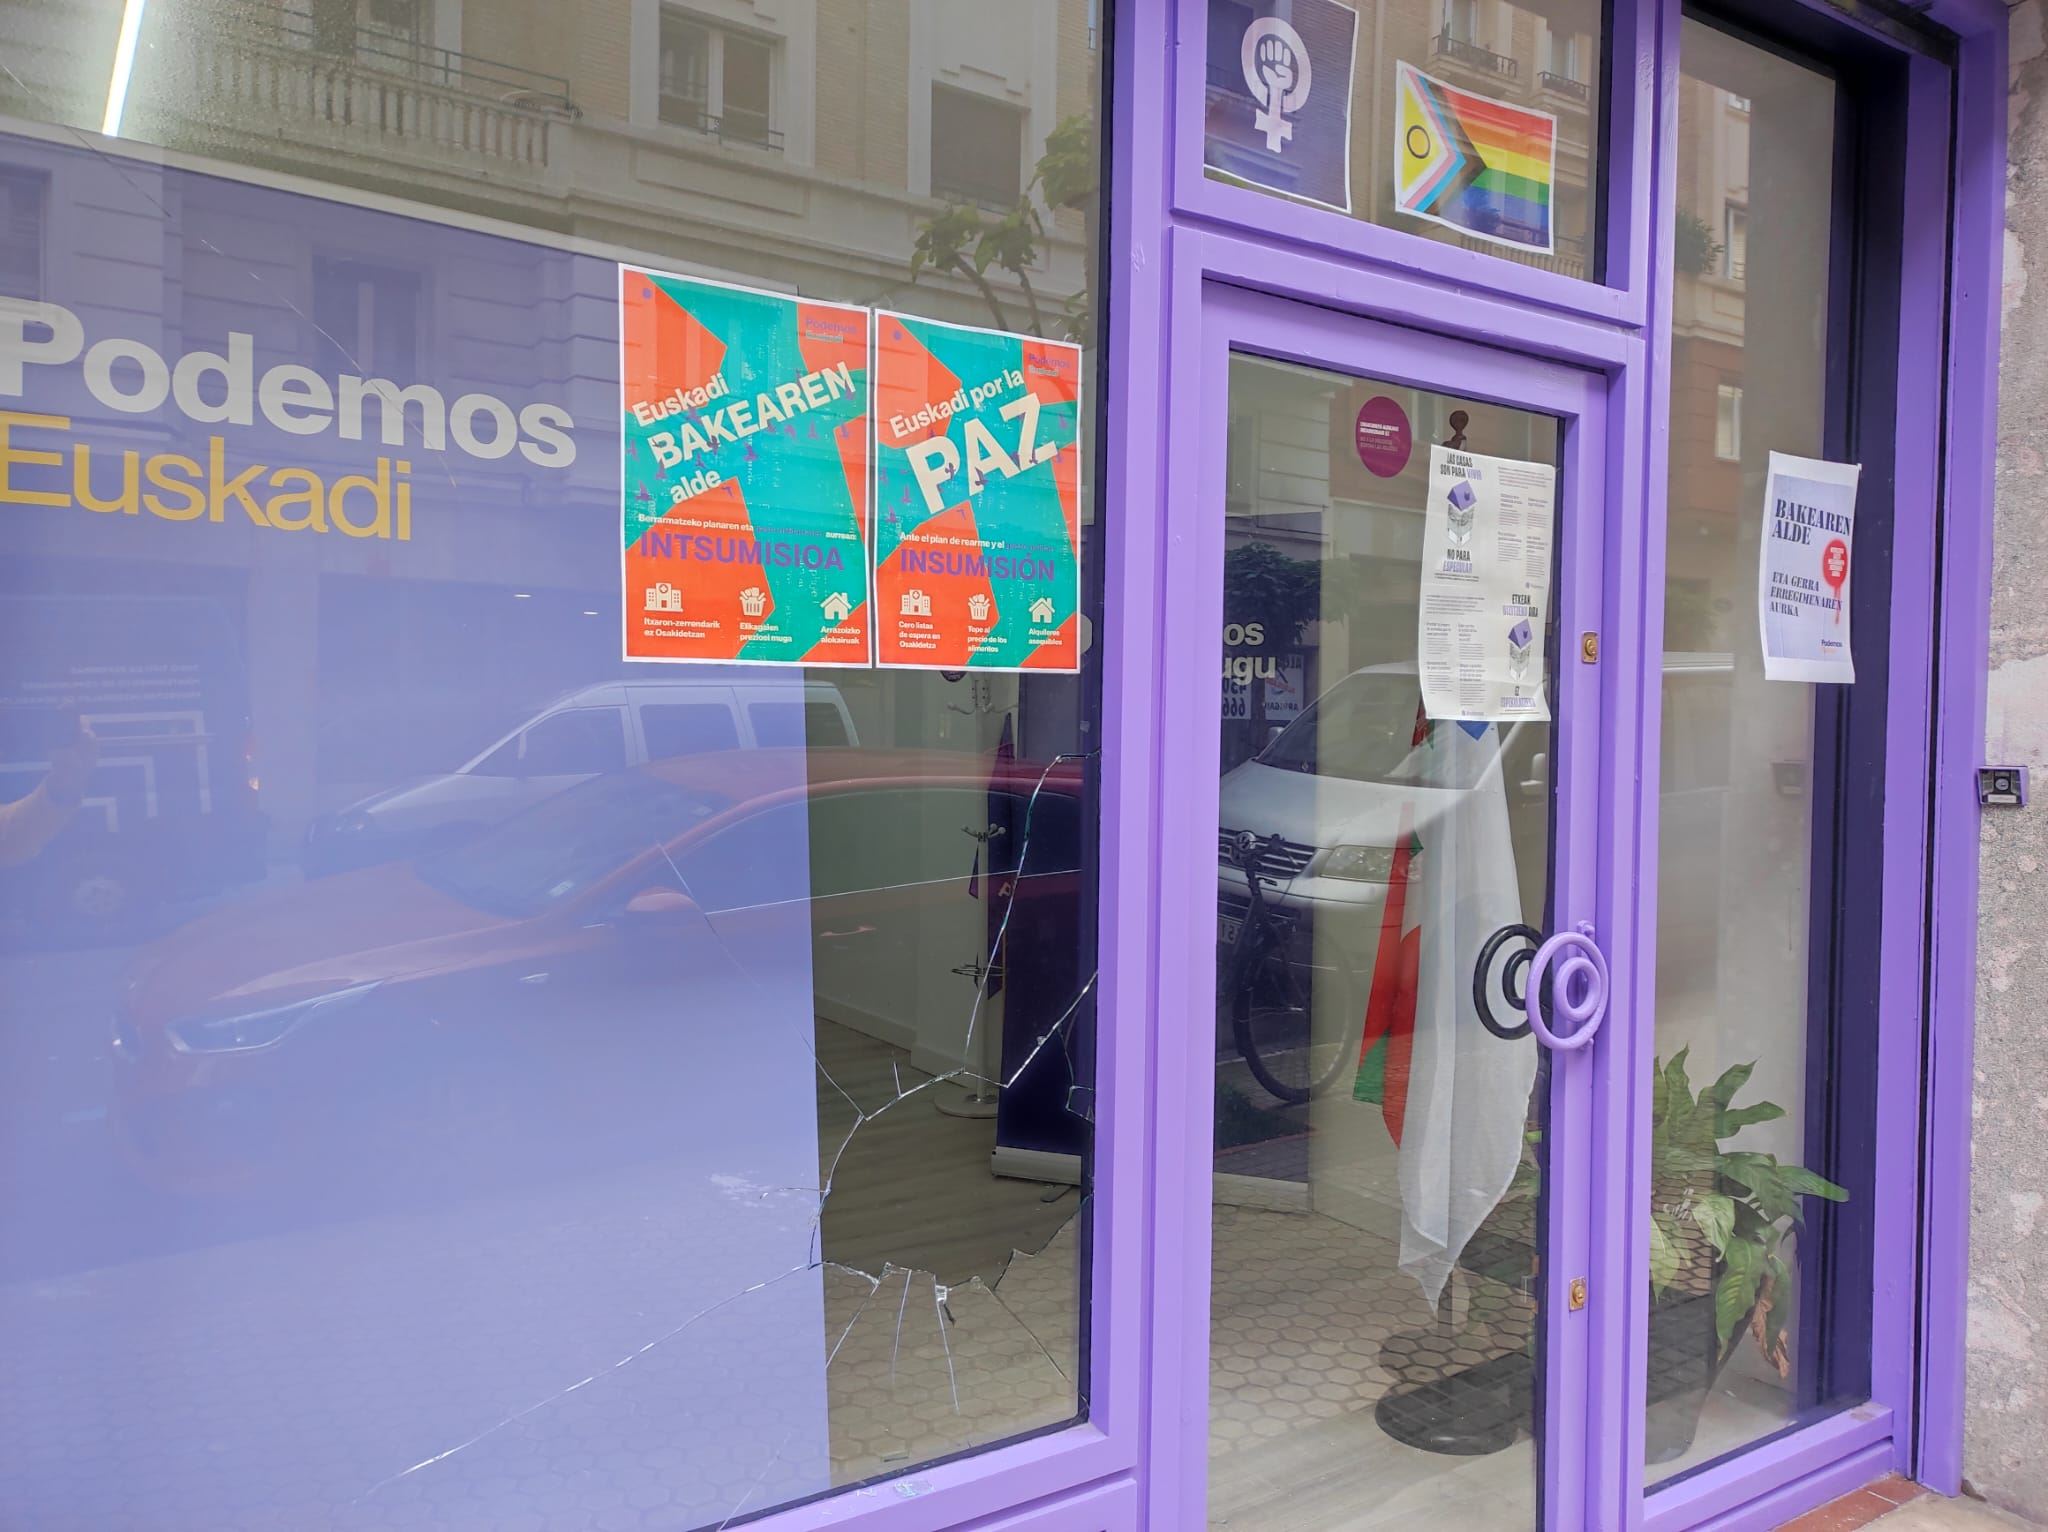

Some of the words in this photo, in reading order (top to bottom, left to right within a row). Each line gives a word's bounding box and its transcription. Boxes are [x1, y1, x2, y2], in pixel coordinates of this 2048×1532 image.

[0, 296, 576, 469] Podemos
[632, 373, 730, 427] Euskadi
[889, 388, 970, 438] Euskadi
[970, 376, 1004, 408] por
[1002, 369, 1025, 390] la
[647, 361, 856, 469] BAKEAREN
[905, 393, 1058, 514] PAZ
[1446, 453, 1456, 465] LAS
[1456, 454, 1473, 468] CASAS
[0, 411, 412, 541] Euskadi
[1440, 463, 1451, 475] SON
[1451, 466, 1466, 478] PARA
[670, 470, 722, 504] alde
[703, 519, 740, 531] planaren
[741, 522, 754, 531] eta
[1775, 498, 1851, 537] BAKEAREN
[1772, 519, 1811, 546] ALDE
[900, 532, 920, 542] Ante
[930, 536, 949, 546] plan
[949, 537, 960, 545] de
[961, 539, 990, 548] rearme
[991, 541, 997, 550] y
[997, 540, 1005, 549] el
[641, 530, 844, 571] INTSUMISIOA
[1447, 548, 1455, 560] NO
[1455, 550, 1471, 562] PARA
[900, 548, 1055, 582] INSUMISIÓN
[1772, 571, 1789, 586] ETA
[1791, 575, 1820, 592] GERRA
[1770, 586, 1842, 611] ERREGIMENAREN
[1769, 601, 1799, 617] AURKA
[644, 617, 720, 629] Itxaron-zerrendarik
[820, 625, 861, 636] Arrazoizko
[899, 621, 914, 629] Cero
[915, 621, 933, 630] listas
[968, 626, 983, 635] Tope
[984, 626, 990, 634] al
[644, 629, 654, 637] ez
[655, 628, 706, 639] Osakidetzan
[771, 635, 793, 644] muga
[820, 635, 860, 645] alokairuak
[899, 631, 907, 639] de
[907, 632, 931, 641] espera
[967, 635, 989, 645] precio
[989, 636, 997, 644] de
[998, 636, 1007, 644] los
[899, 641, 936, 649] Osakidetza
[1821, 638, 1843, 648] Podemos
